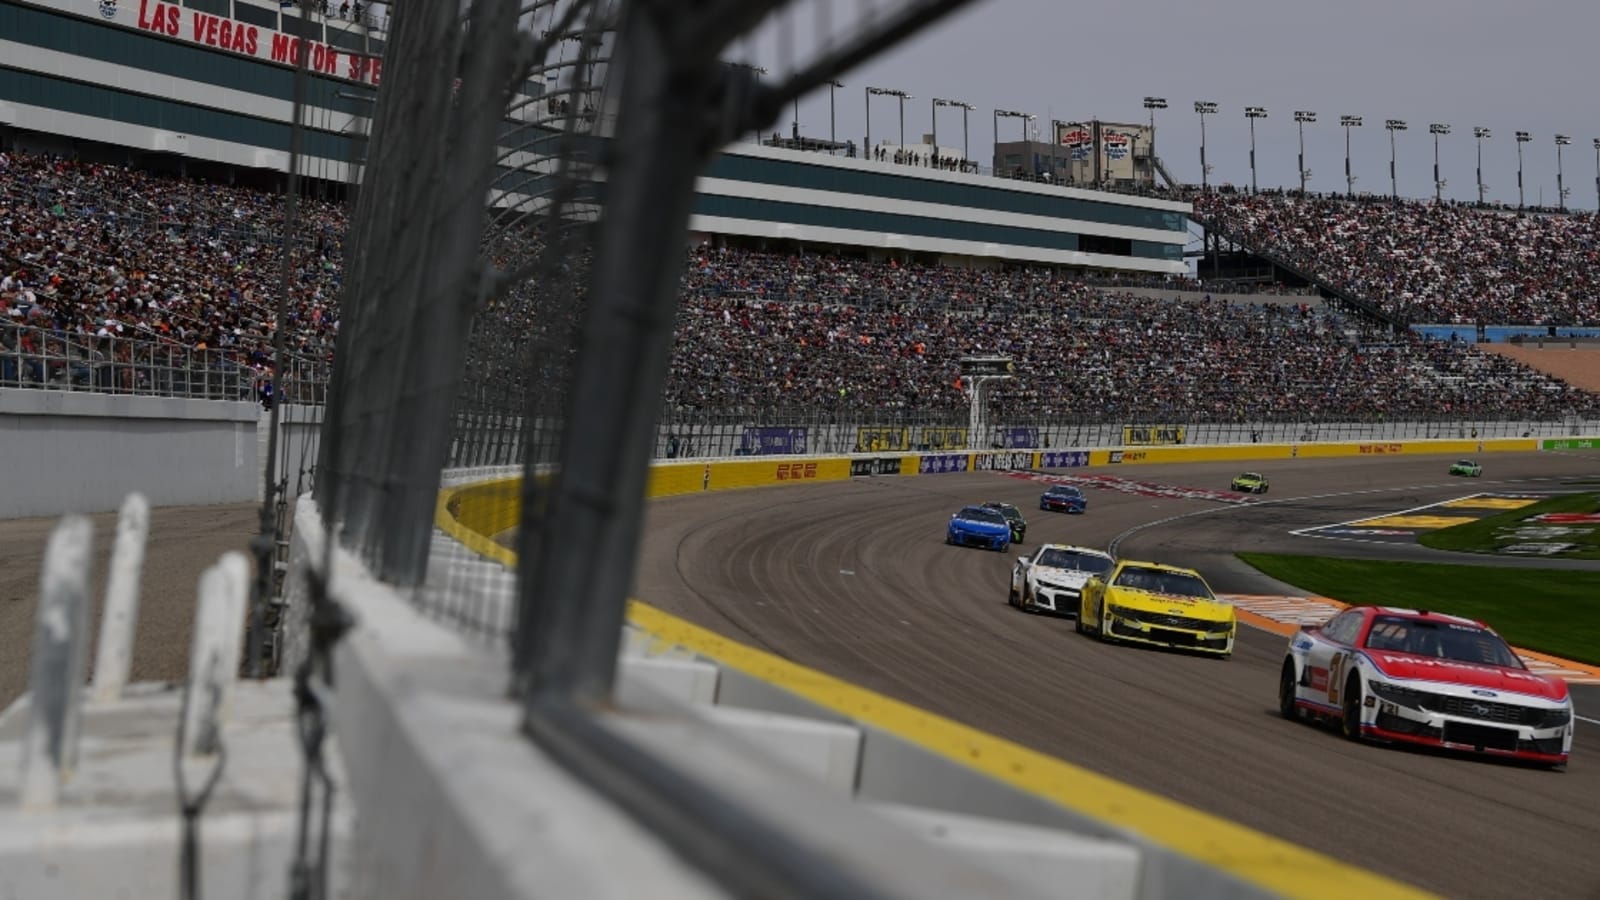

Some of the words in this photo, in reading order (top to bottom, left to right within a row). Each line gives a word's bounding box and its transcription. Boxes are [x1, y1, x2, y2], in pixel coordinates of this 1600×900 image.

[138, 0, 181, 36] LAS
[193, 12, 258, 55] VEGAS
[271, 33, 338, 74] MOTOR
